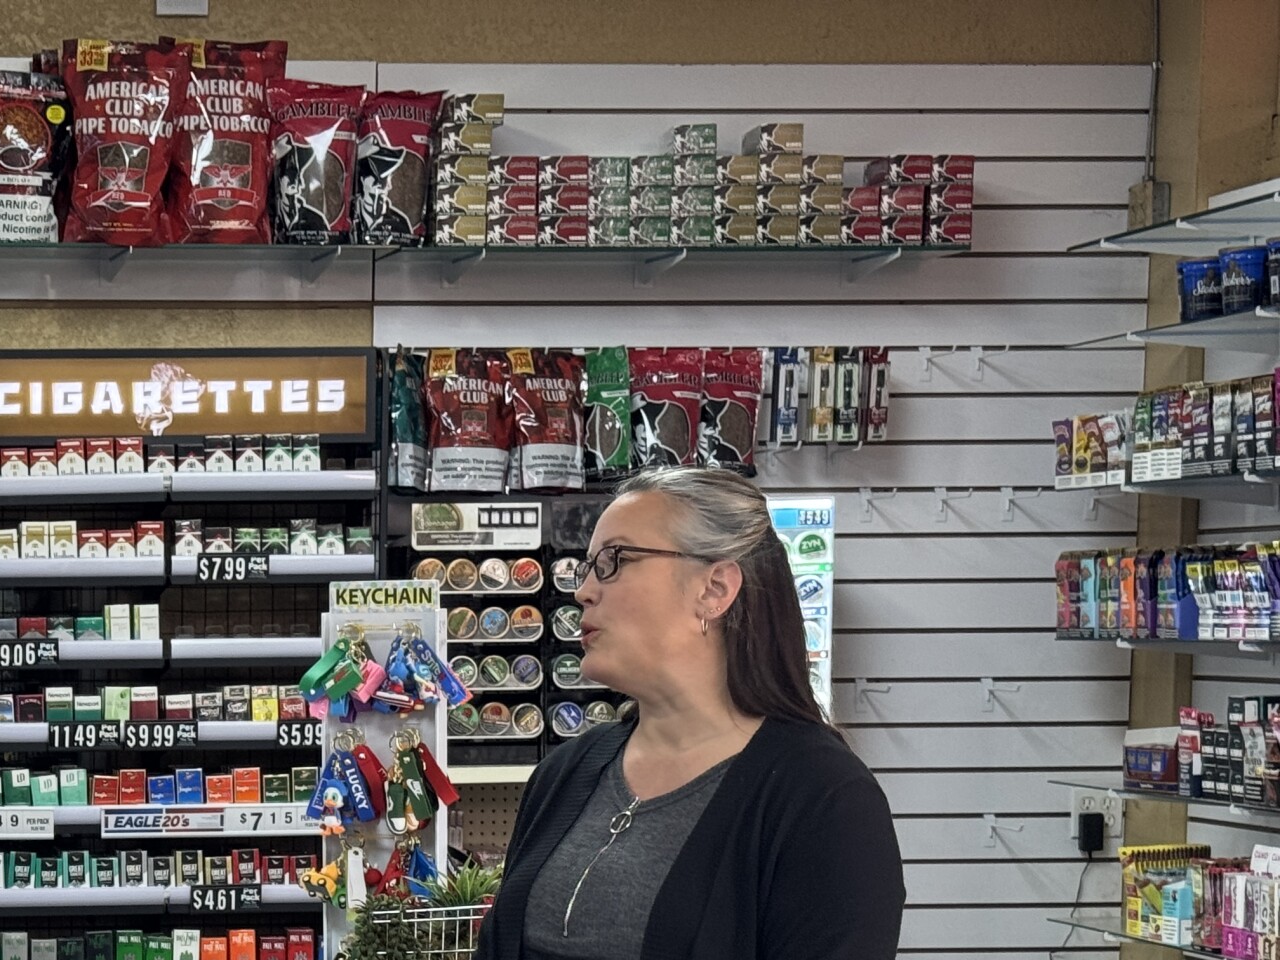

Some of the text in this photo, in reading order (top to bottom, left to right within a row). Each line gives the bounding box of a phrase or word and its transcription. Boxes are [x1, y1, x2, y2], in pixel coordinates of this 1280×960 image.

[85, 81, 169, 101] AMERICAN
[186, 79, 264, 102] AMERICAN
[105, 98, 144, 116] CLUB
[207, 97, 243, 114] CLUB
[75, 117, 173, 139] PIPE TOBACCO
[212, 116, 270, 135] TOBACCO
[3, 224, 42, 234] Nicotine
[443, 378, 503, 395] AMERICAN
[460, 391, 488, 404] CLUB
[542, 391, 567, 402] CLUB
[802, 539, 822, 550] ZYN
[199, 558, 245, 580] $7.99
[248, 563, 267, 571] Pack
[336, 587, 432, 605] KEYCHAIN
[126, 725, 174, 748] $9.99
[279, 724, 322, 746] $5.99
[345, 767, 369, 810] LUCKY
[193, 889, 236, 911] $4.61
[240, 894, 259, 902] Pack
[131, 935, 142, 943] MALL
